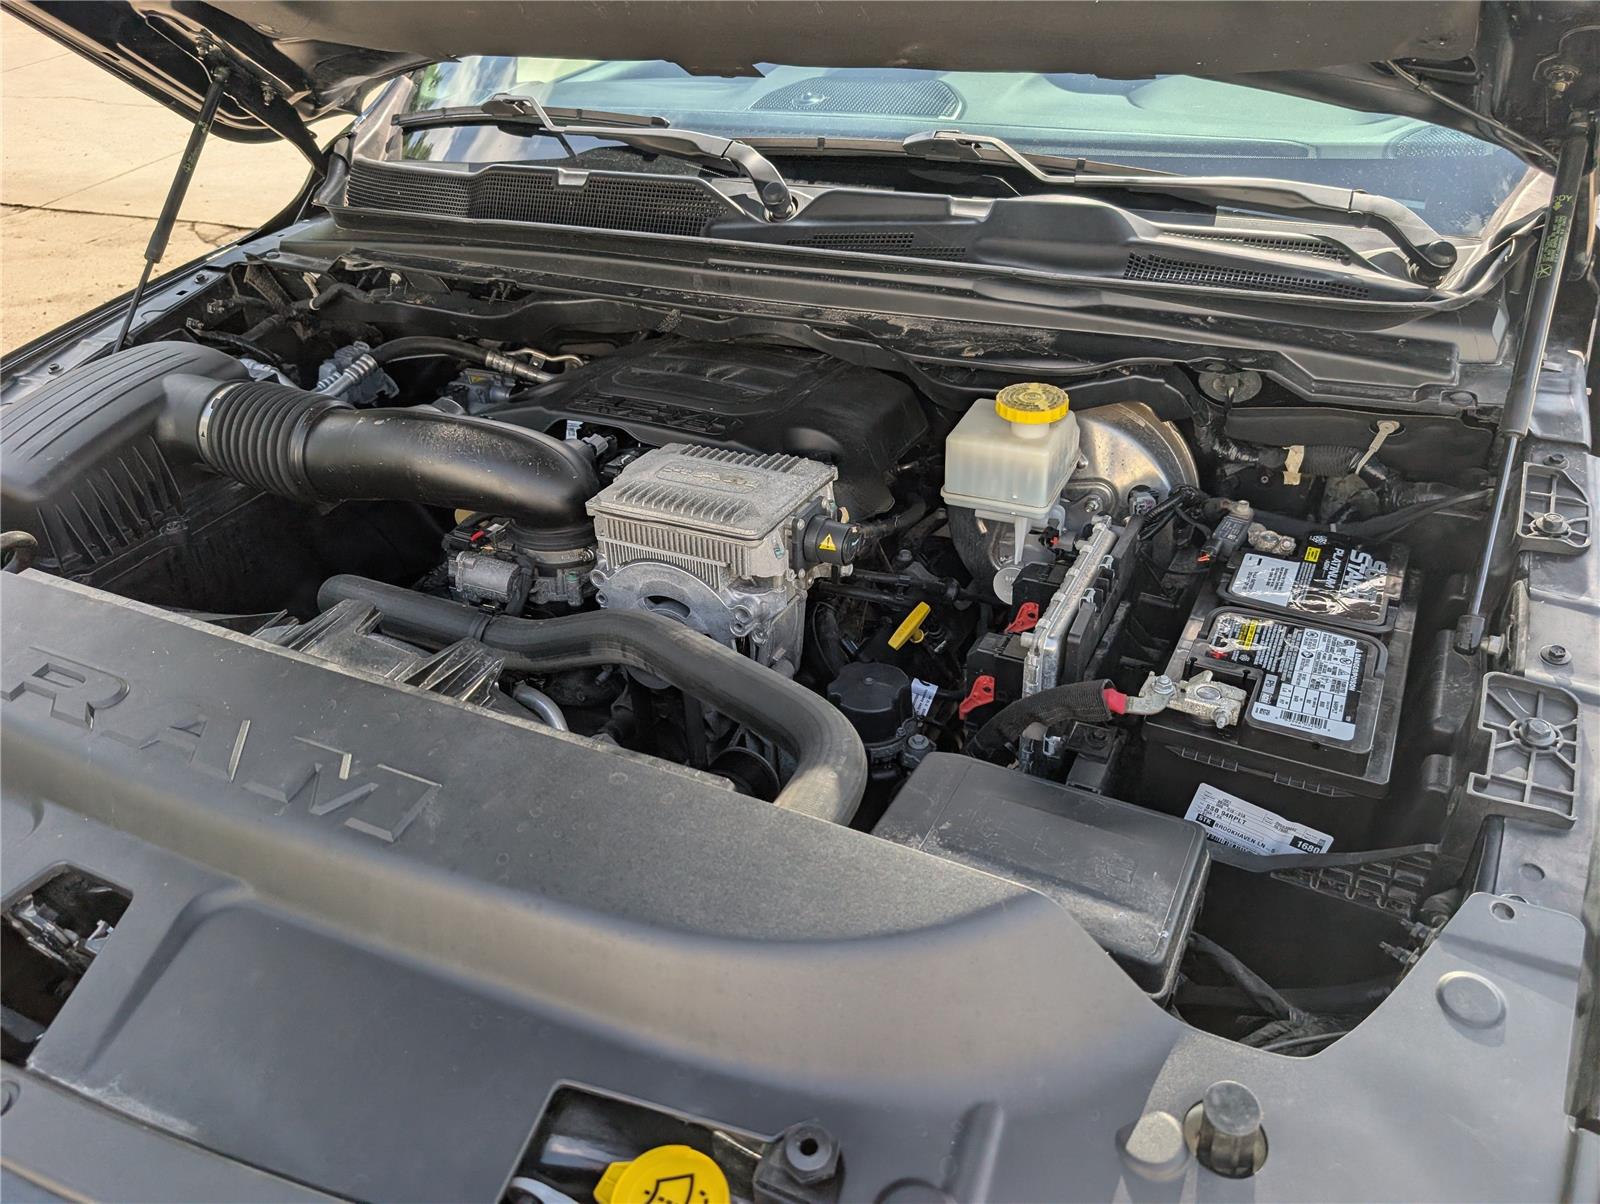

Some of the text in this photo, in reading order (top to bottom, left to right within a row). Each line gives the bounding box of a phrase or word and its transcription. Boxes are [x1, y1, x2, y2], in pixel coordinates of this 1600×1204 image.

[1325, 548, 1345, 589] PLATINUM
[0, 646, 443, 843] RAM
[1198, 815, 1212, 826] STK
[1214, 823, 1257, 845] BROOKHAVEN
[1257, 840, 1267, 849] LN
[1221, 810, 1248, 825] 94RPLT
[1295, 840, 1321, 854] 1680
